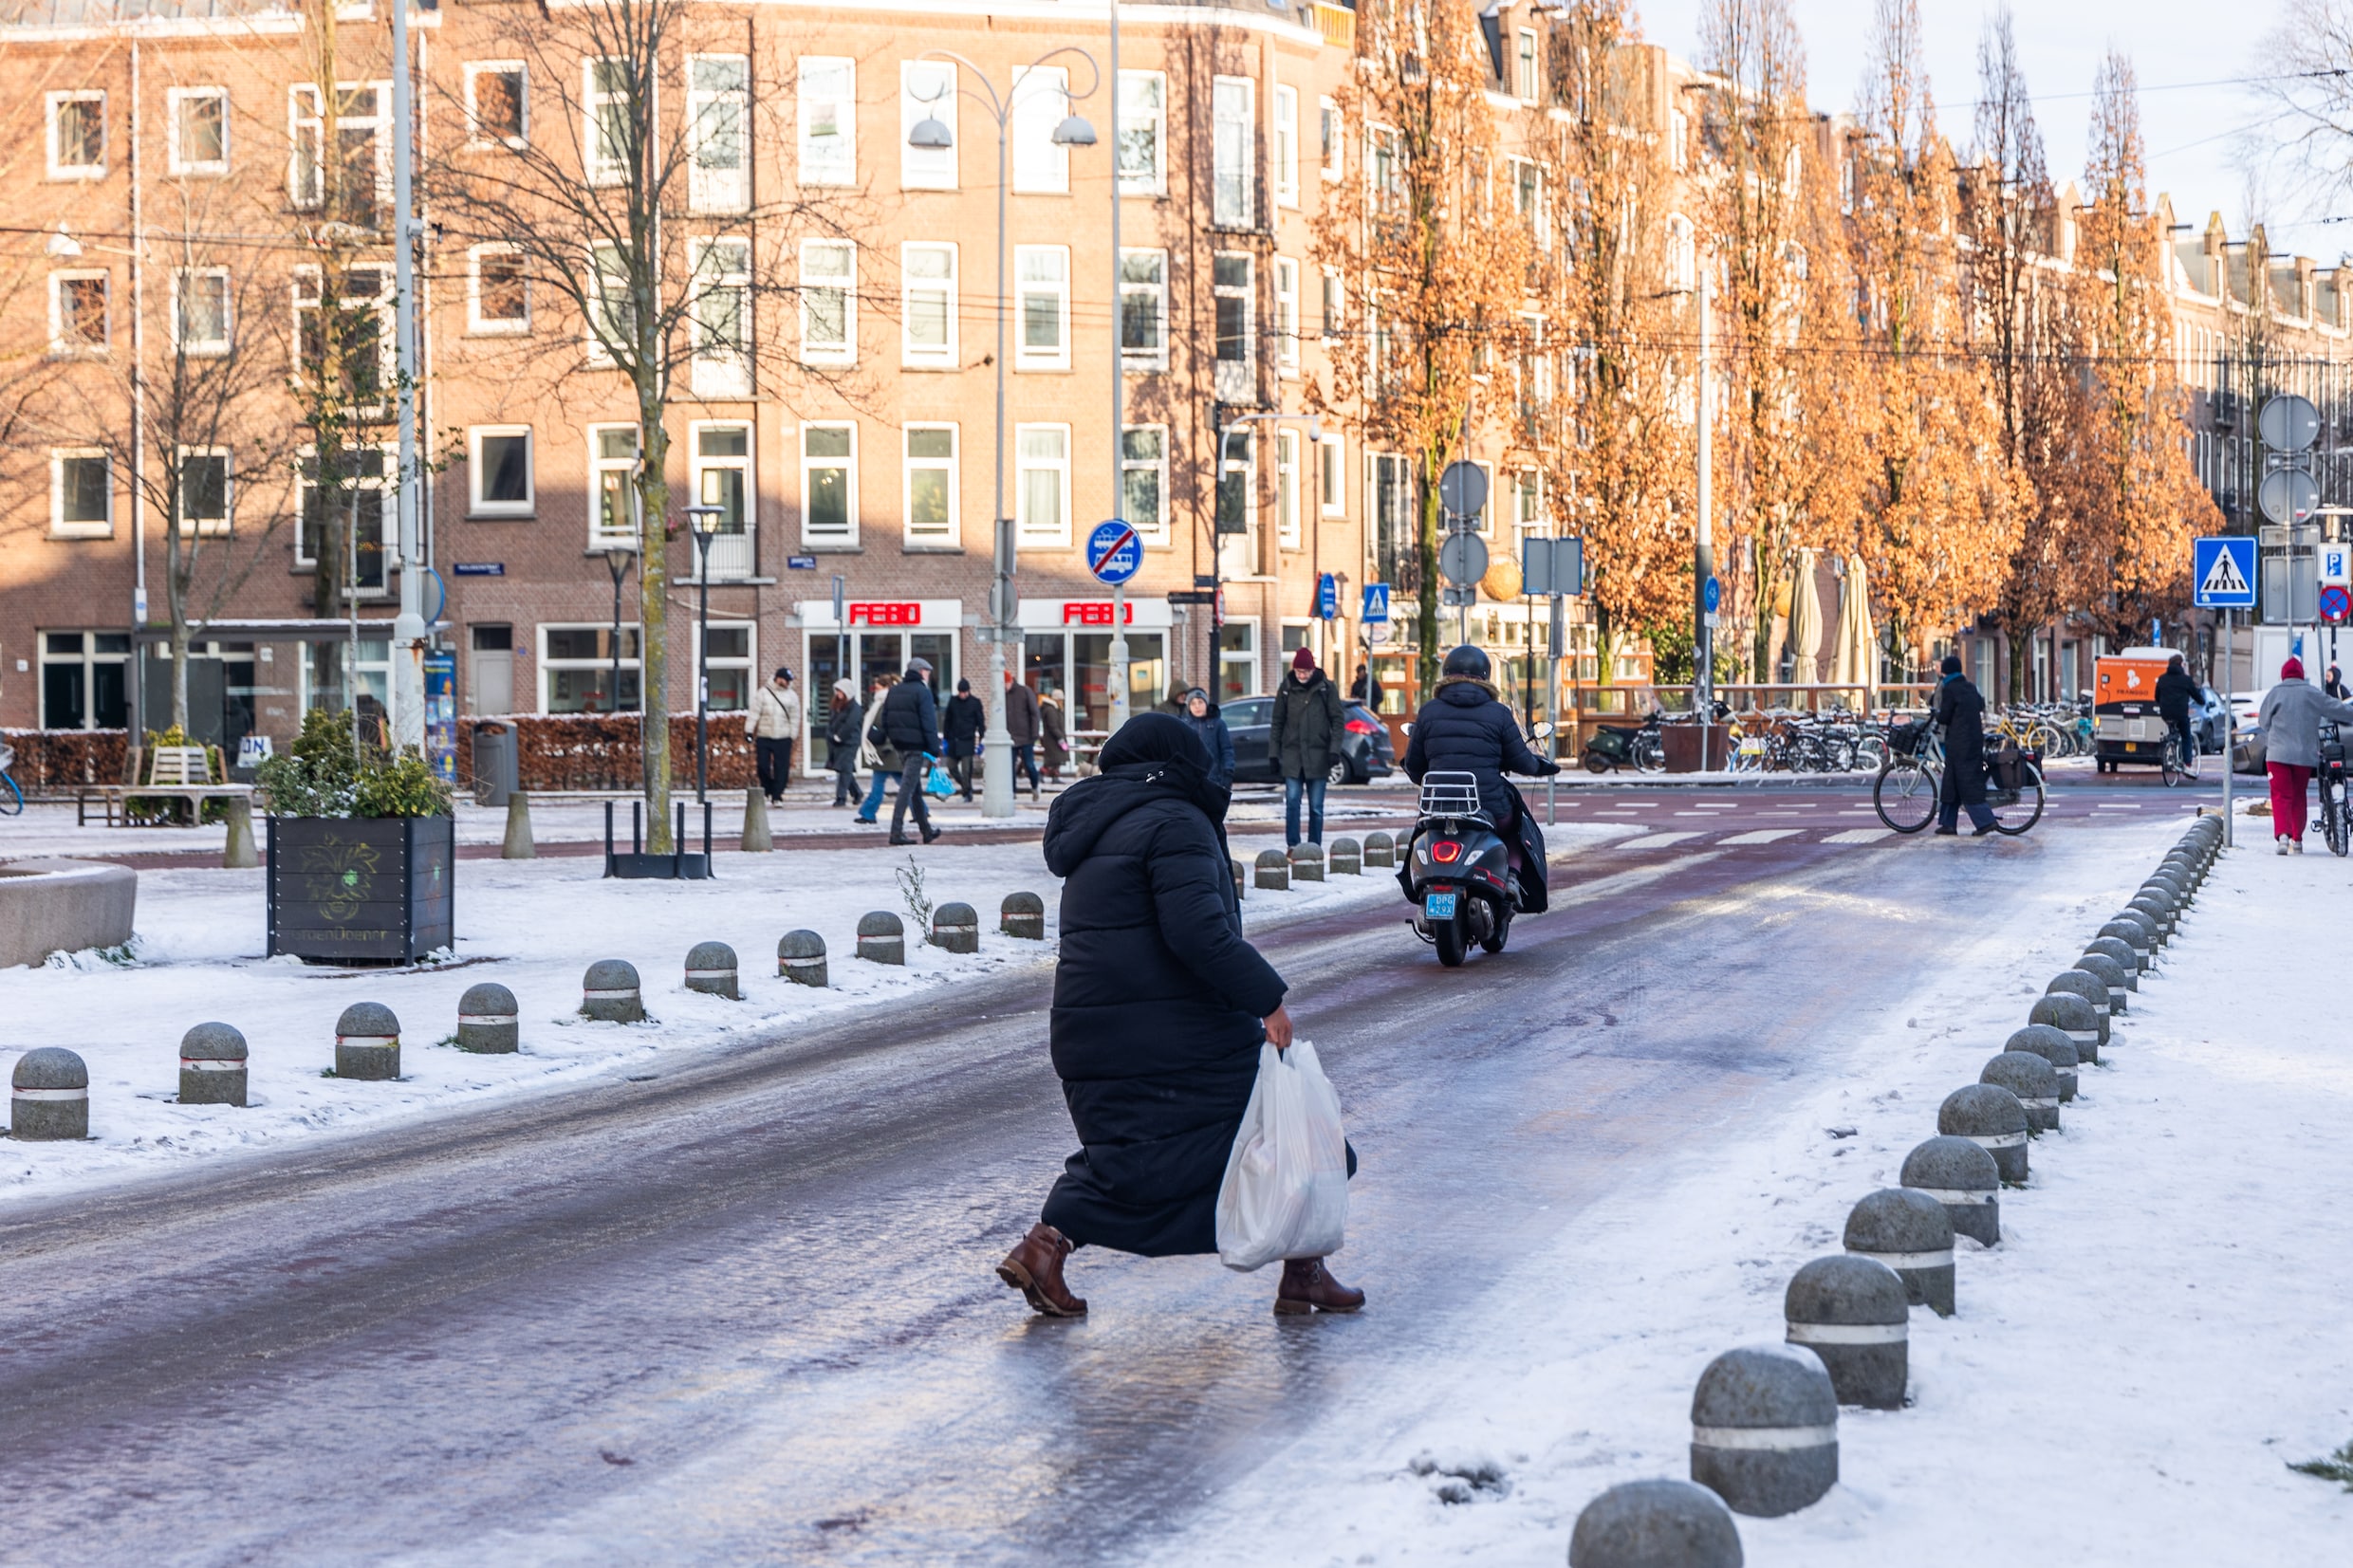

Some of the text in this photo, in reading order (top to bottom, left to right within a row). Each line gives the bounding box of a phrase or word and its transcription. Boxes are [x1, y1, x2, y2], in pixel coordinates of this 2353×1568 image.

[850, 603, 920, 624] FEBO
[1436, 895, 1453, 905] DPG
[1436, 906, 1452, 914] 29X
